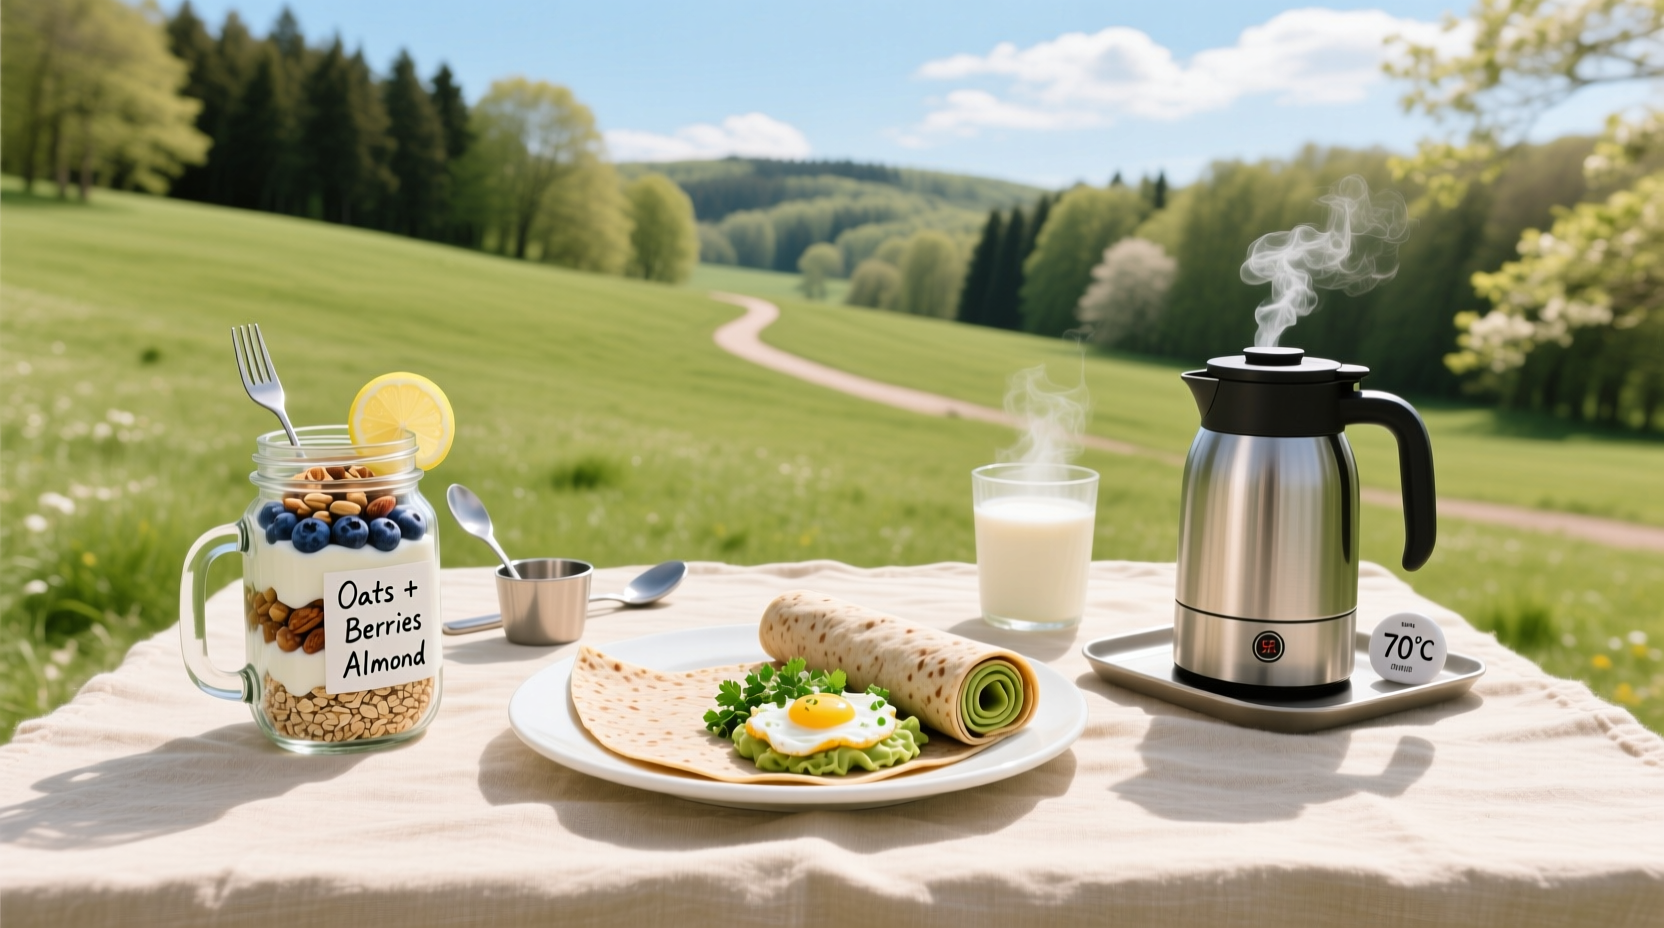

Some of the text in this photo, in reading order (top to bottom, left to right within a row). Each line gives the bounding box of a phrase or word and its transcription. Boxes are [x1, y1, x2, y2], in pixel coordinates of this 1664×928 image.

[338, 580, 418, 609] Oats +
[345, 612, 421, 644] Berries
[343, 639, 425, 679] Almond
[1384, 632, 1435, 661] 70°C
